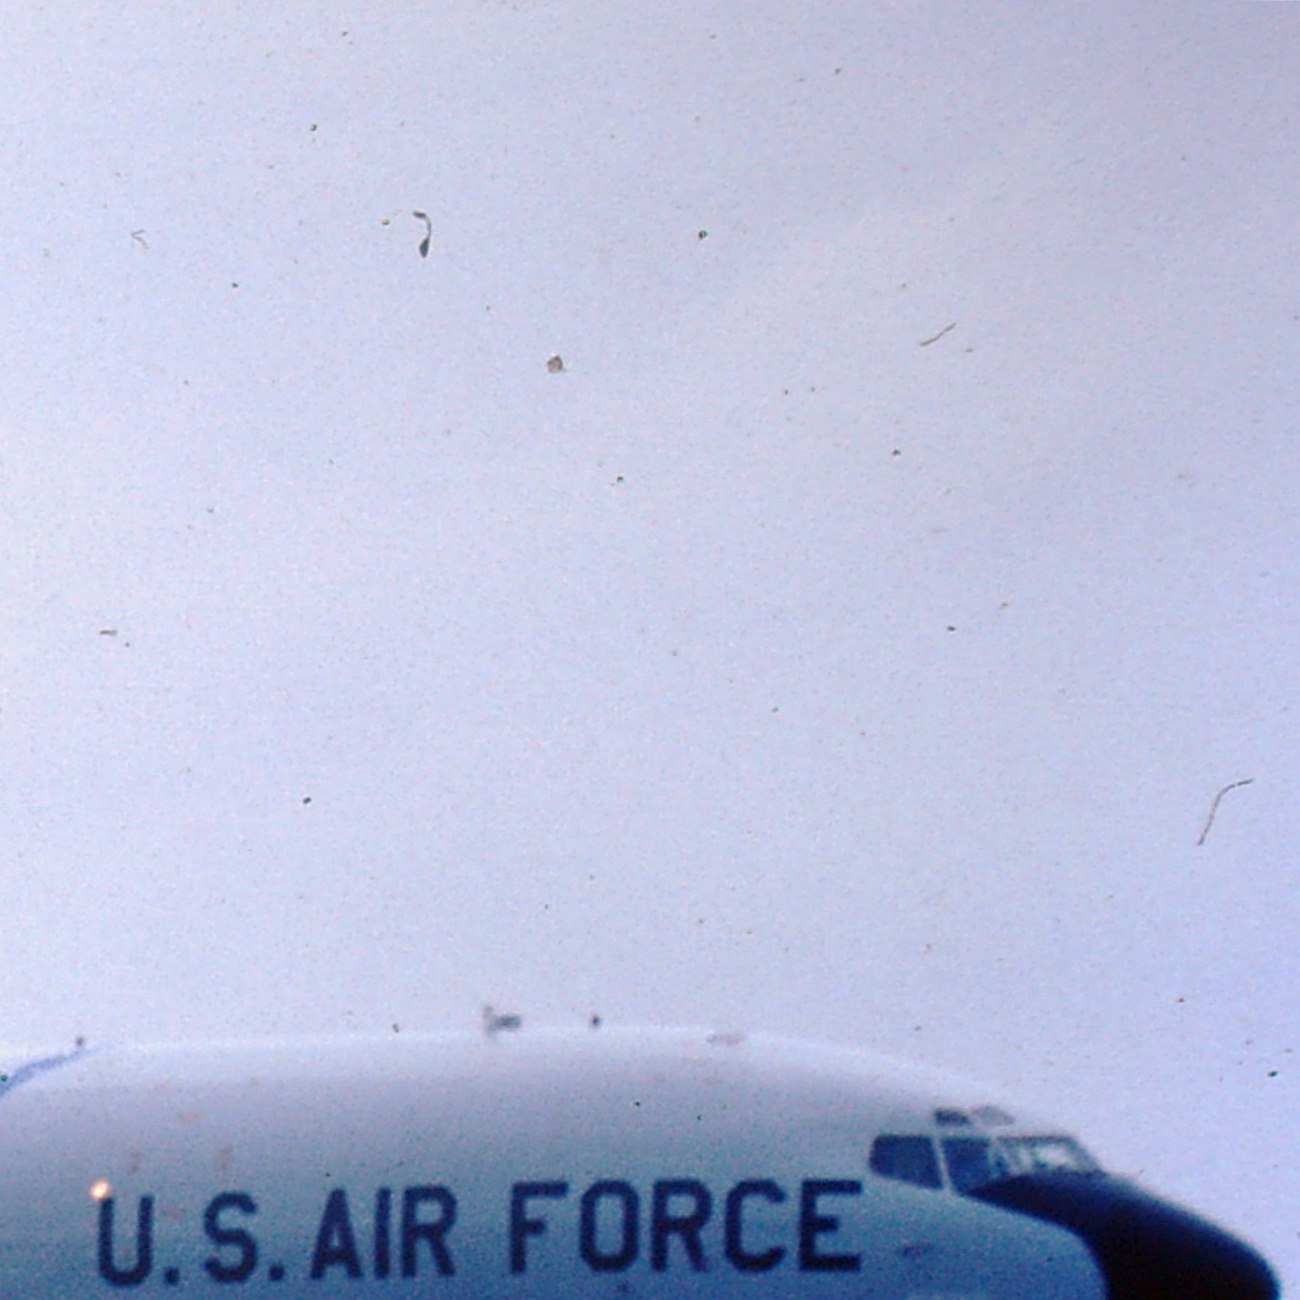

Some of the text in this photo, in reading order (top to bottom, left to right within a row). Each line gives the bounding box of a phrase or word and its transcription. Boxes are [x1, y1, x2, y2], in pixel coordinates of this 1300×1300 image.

[98, 1177, 862, 1287] U.S. AIR FORCE
